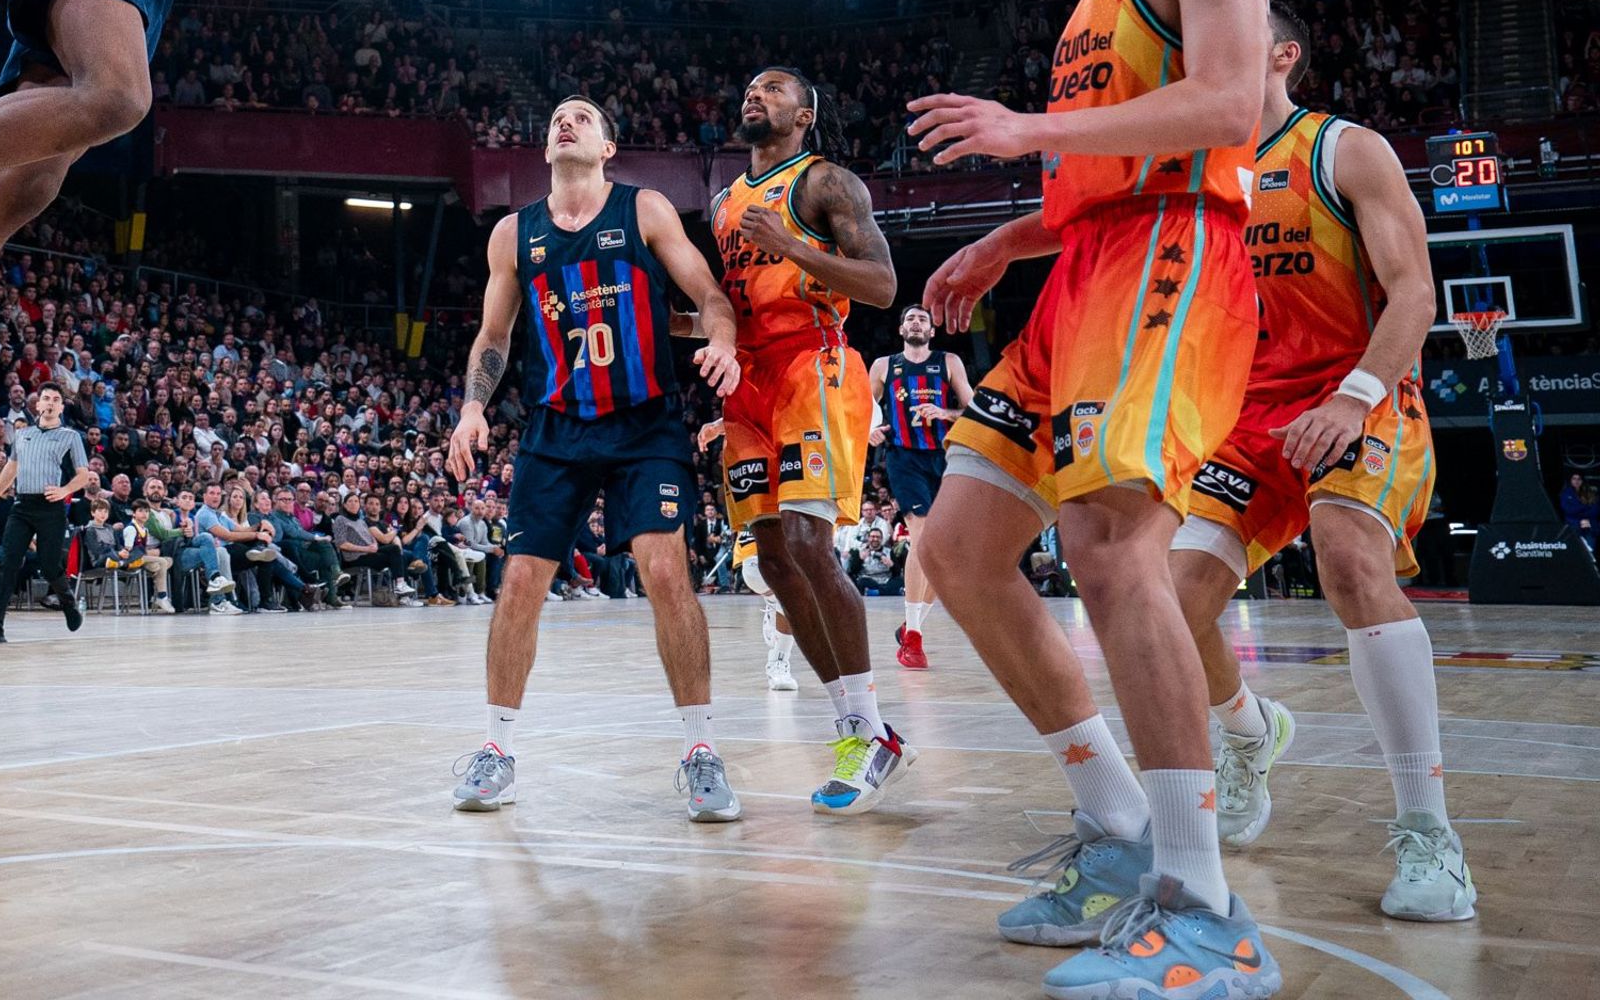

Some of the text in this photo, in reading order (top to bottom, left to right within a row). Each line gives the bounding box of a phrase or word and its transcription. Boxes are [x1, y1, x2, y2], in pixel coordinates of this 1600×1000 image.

[1091, 31, 1114, 51] del
[1458, 160, 1496, 187] 20
[1284, 227, 1311, 243] del
[571, 281, 632, 303] Assistència
[573, 297, 616, 314] Sanitària
[567, 322, 615, 370] 20
[1075, 406, 1098, 415] acb
[729, 463, 764, 480] PULEVA
[1515, 541, 1567, 550] Assistència
